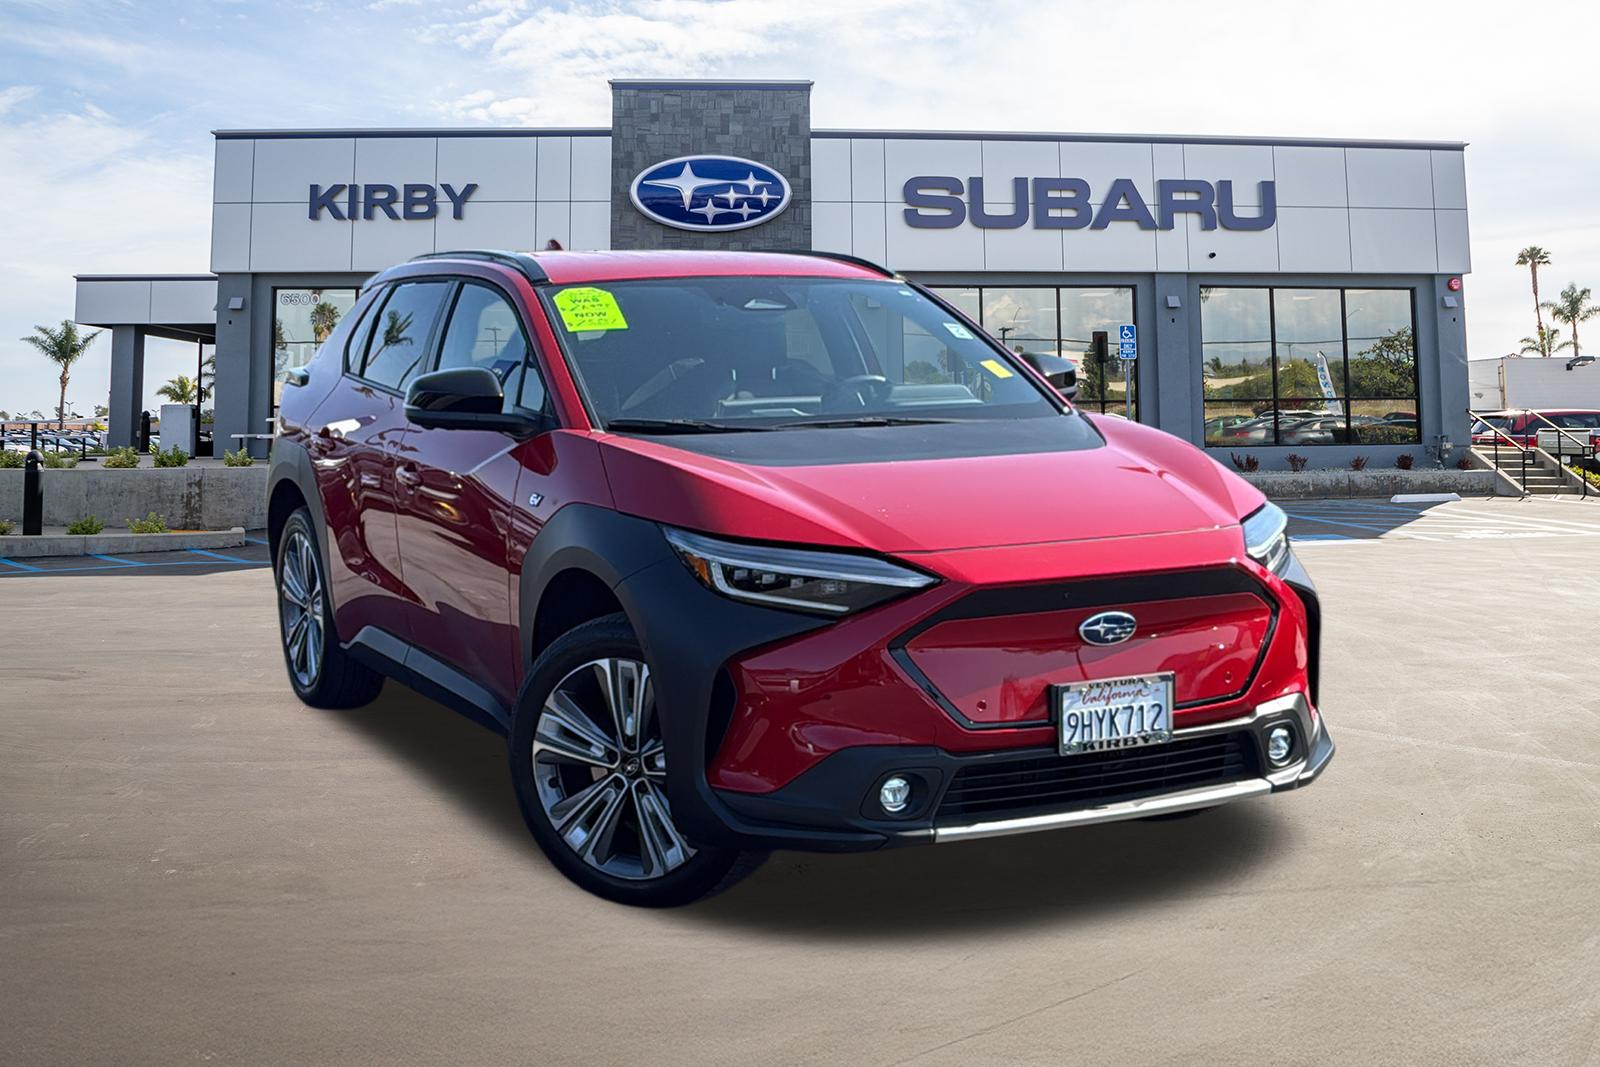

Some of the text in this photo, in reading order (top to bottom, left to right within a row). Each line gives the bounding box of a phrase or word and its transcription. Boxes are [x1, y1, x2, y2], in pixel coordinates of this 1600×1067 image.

[309, 184, 478, 220] KIRBY
[903, 176, 1278, 231] SUBARU
[1083, 688, 1149, 705] California
[1088, 678, 1146, 689] VENTURA
[1067, 702, 1163, 743] 9HYK712
[1082, 735, 1151, 751] KIRBY
